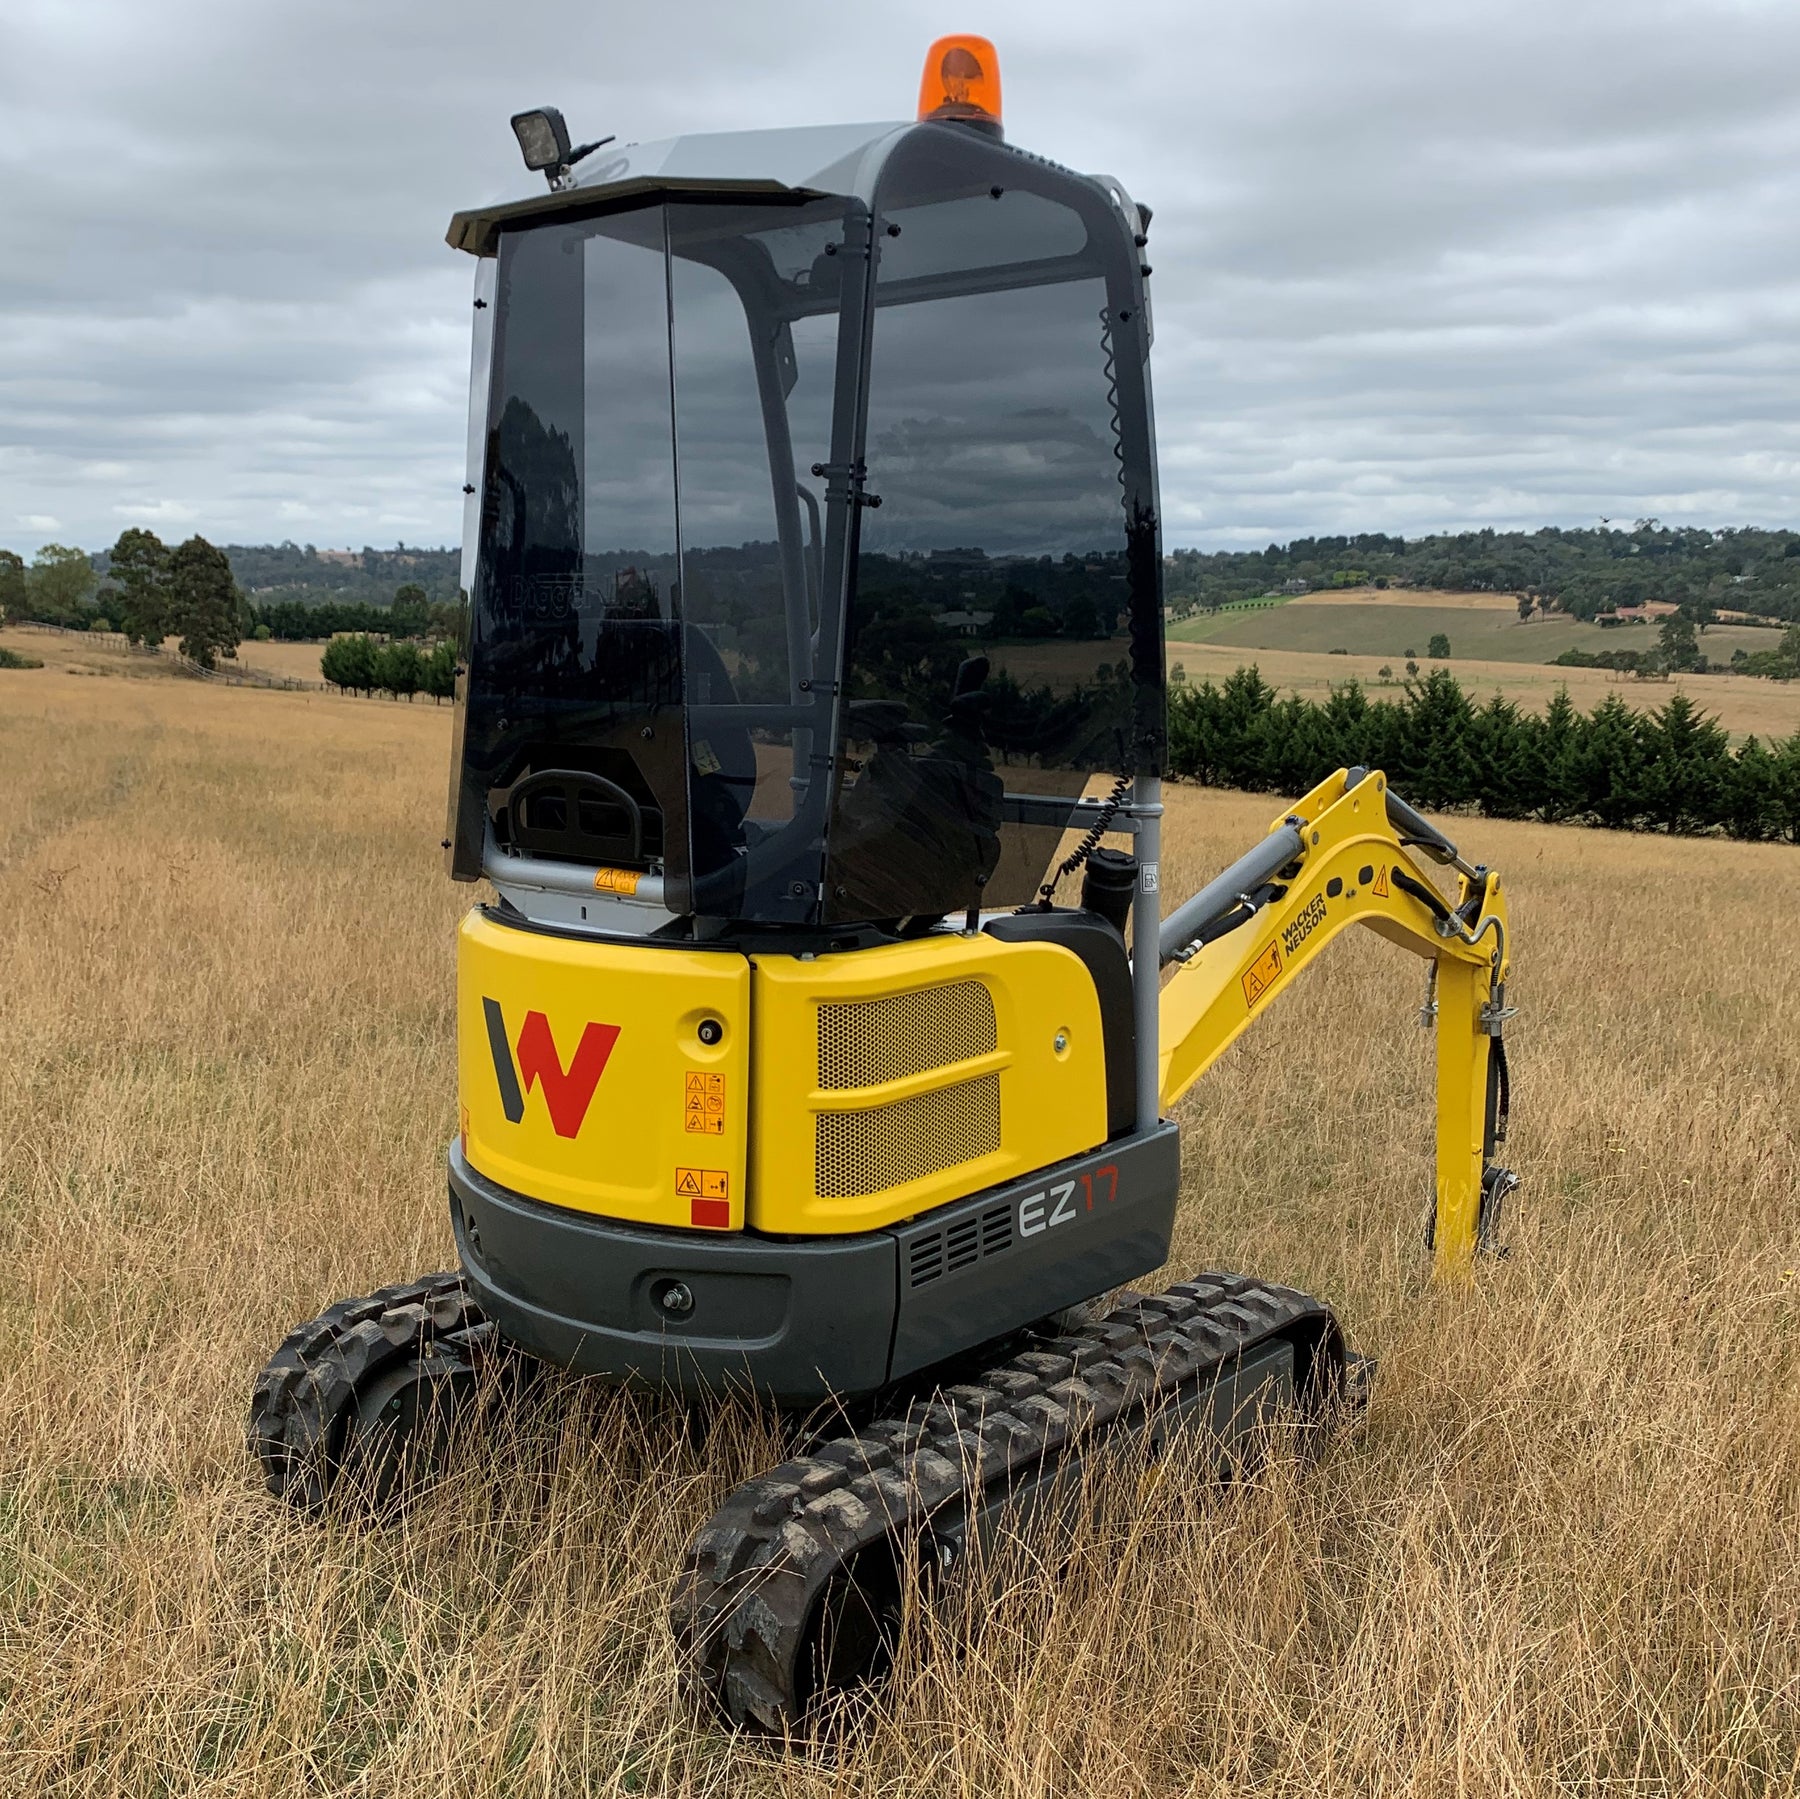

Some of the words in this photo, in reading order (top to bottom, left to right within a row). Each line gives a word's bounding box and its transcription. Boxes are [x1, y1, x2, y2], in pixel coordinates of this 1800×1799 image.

[1281, 893, 1324, 942] WACKER
[1285, 904, 1327, 958] NEUSON
[1019, 1164, 1119, 1238] EZ17
